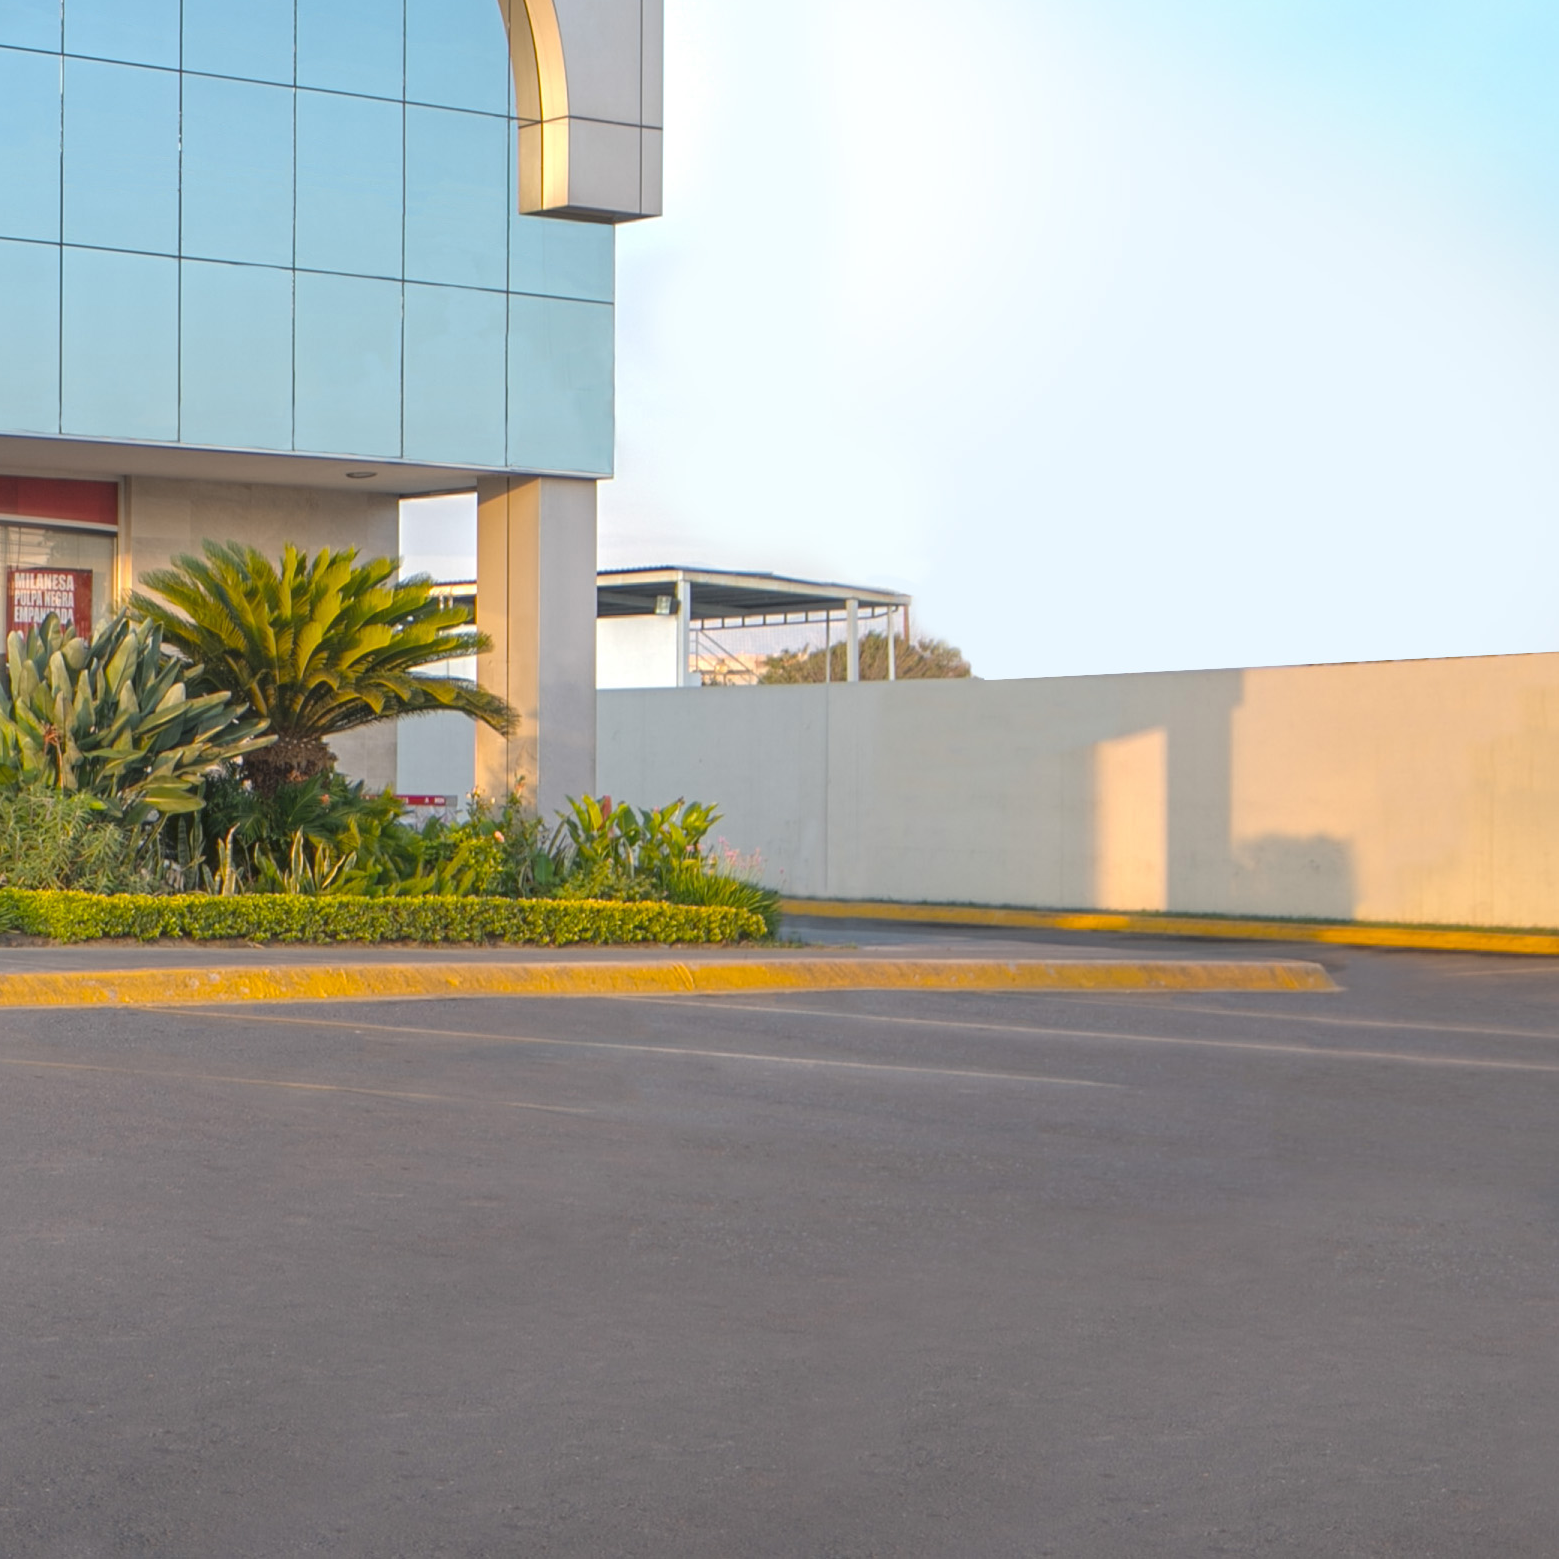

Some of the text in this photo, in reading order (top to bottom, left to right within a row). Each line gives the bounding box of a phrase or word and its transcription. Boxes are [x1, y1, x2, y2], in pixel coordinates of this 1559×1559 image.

[14, 572, 75, 591] MILANESA
[14, 589, 75, 608] PULPA NEGRA
